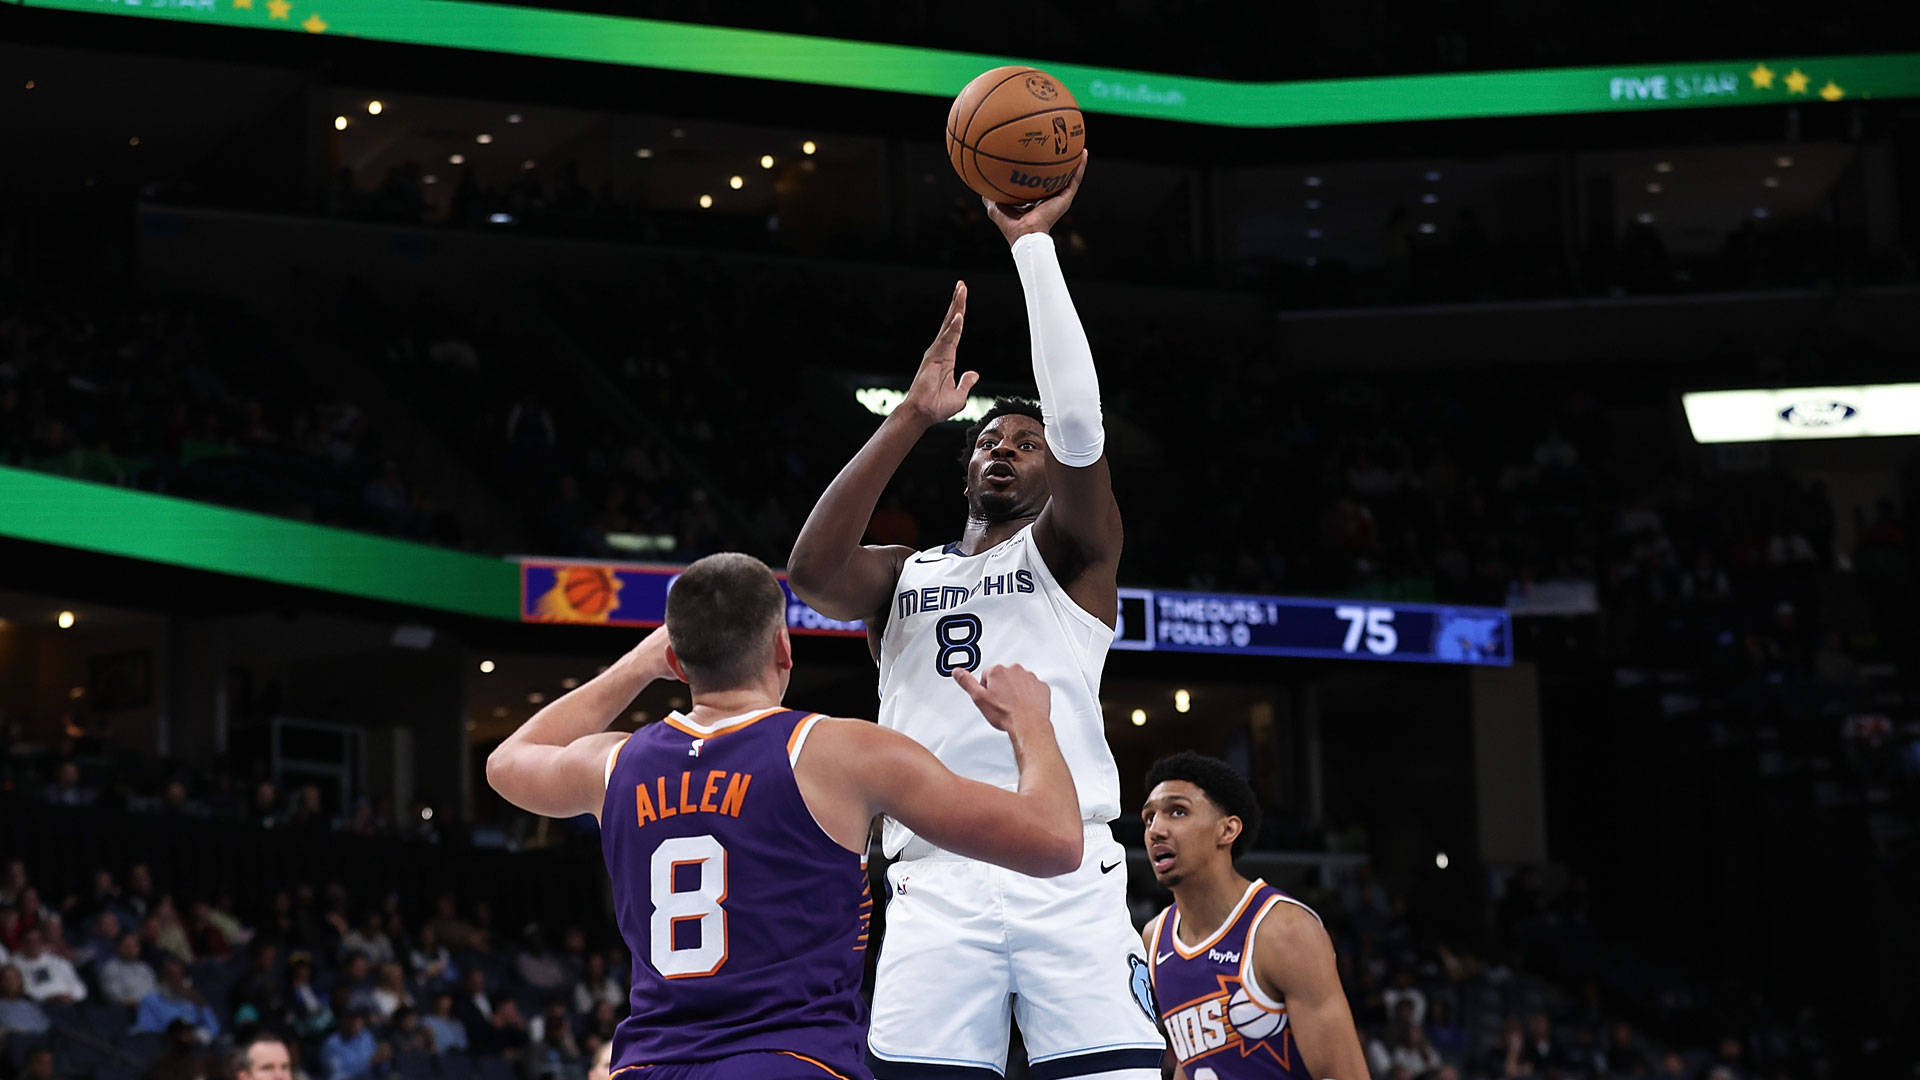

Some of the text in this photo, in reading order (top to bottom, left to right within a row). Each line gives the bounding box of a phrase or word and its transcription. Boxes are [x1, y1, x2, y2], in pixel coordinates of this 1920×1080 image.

[1610, 72, 1740, 101] FIVE STAR
[936, 613, 982, 677] 8
[1336, 606, 1399, 655] 75
[636, 770, 752, 828] ALLEN
[650, 834, 728, 980] 8
[1208, 948, 1241, 964] PayPal
[1164, 1000, 1227, 1062] UNS
